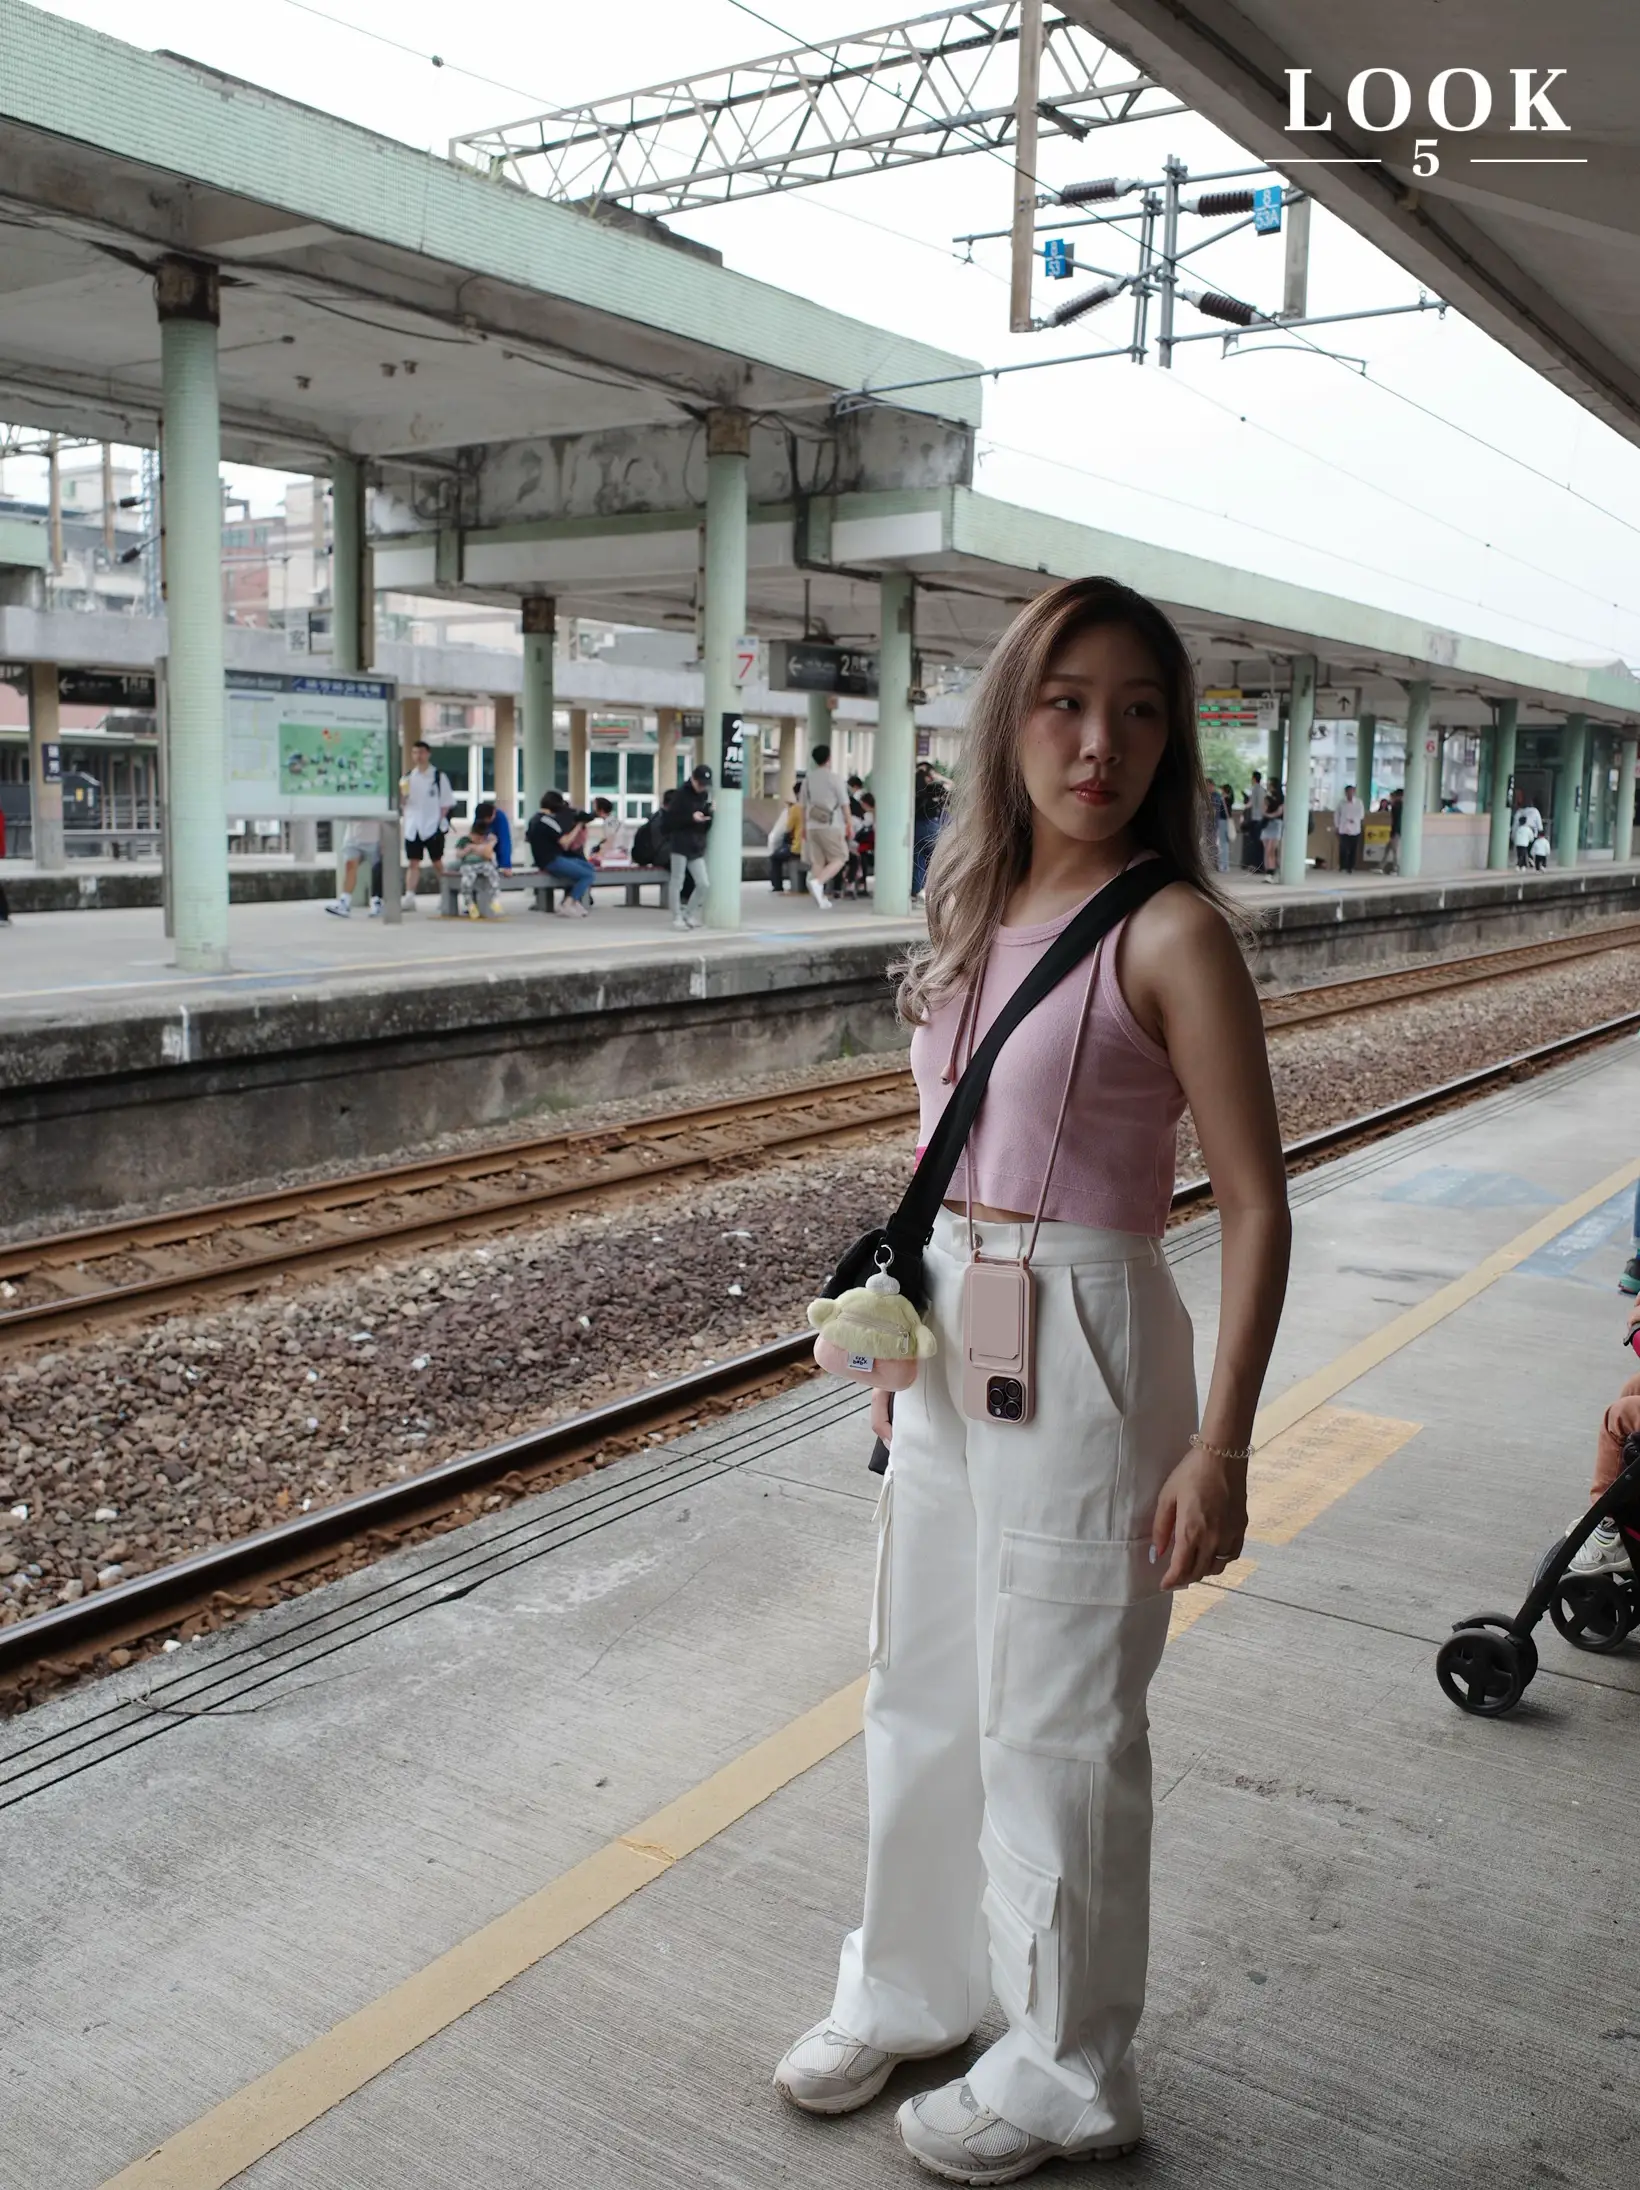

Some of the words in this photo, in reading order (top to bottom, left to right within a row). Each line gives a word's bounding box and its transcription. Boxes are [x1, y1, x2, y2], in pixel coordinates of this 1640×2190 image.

[1255, 208, 1280, 230] 53A
[1047, 259, 1061, 277] 53
[737, 652, 755, 680] 7
[1426, 740, 1436, 753] 6
